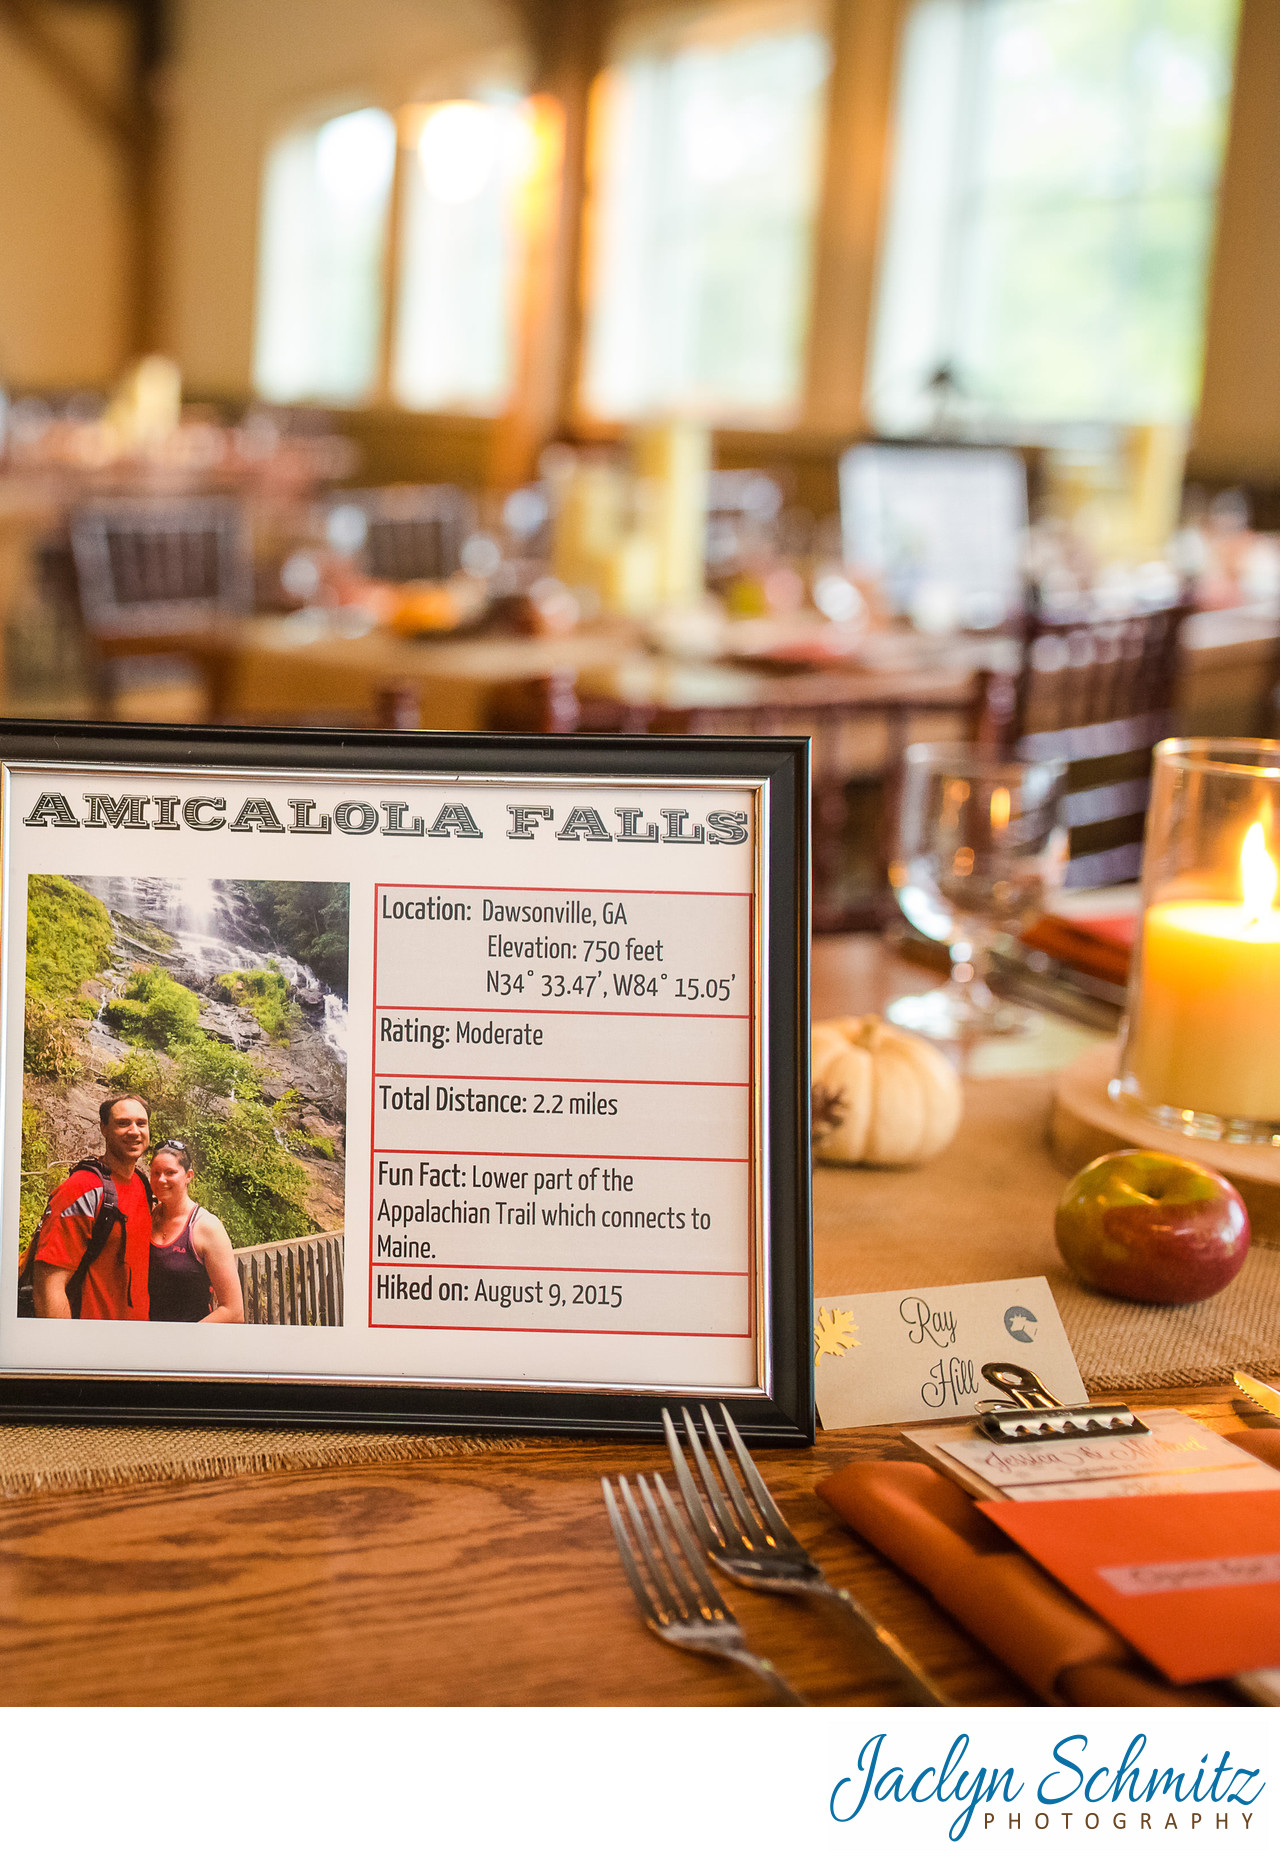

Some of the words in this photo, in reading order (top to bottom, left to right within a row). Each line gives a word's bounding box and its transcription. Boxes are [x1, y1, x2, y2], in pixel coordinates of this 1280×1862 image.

[22, 791, 484, 839] AMICALOLA
[505, 804, 749, 848] FALLS
[382, 894, 472, 921] Location:
[482, 898, 597, 928] Dawsonville,
[602, 902, 628, 925] GA
[488, 933, 577, 960] Elevation:
[583, 940, 620, 963] 750
[624, 937, 664, 962] feet
[380, 1017, 450, 1050] Rating:
[456, 1020, 543, 1046] Moderate
[378, 1084, 430, 1111] Total
[436, 1086, 527, 1114] Distance:
[532, 1093, 564, 1114] 2.2
[569, 1091, 618, 1116] miles
[378, 1160, 414, 1187] Fun
[419, 1161, 467, 1188] Fact:
[472, 1164, 529, 1189] Lower
[534, 1168, 573, 1196] part
[578, 1166, 601, 1191] of
[601, 1167, 634, 1192] the
[376, 1198, 490, 1228] Appalachian
[495, 1201, 536, 1226] Trail
[541, 1202, 596, 1227] which
[601, 1206, 686, 1230] connects
[690, 1207, 711, 1230] to
[377, 1234, 436, 1259] Maine.
[376, 1273, 433, 1301] Hiked
[438, 1282, 469, 1302] on:
[473, 1278, 544, 1309] August
[548, 1283, 567, 1307] 9,
[571, 1284, 623, 1309] 2015
[899, 1296, 958, 1349] Ray
[920, 1356, 980, 1408] Hill
